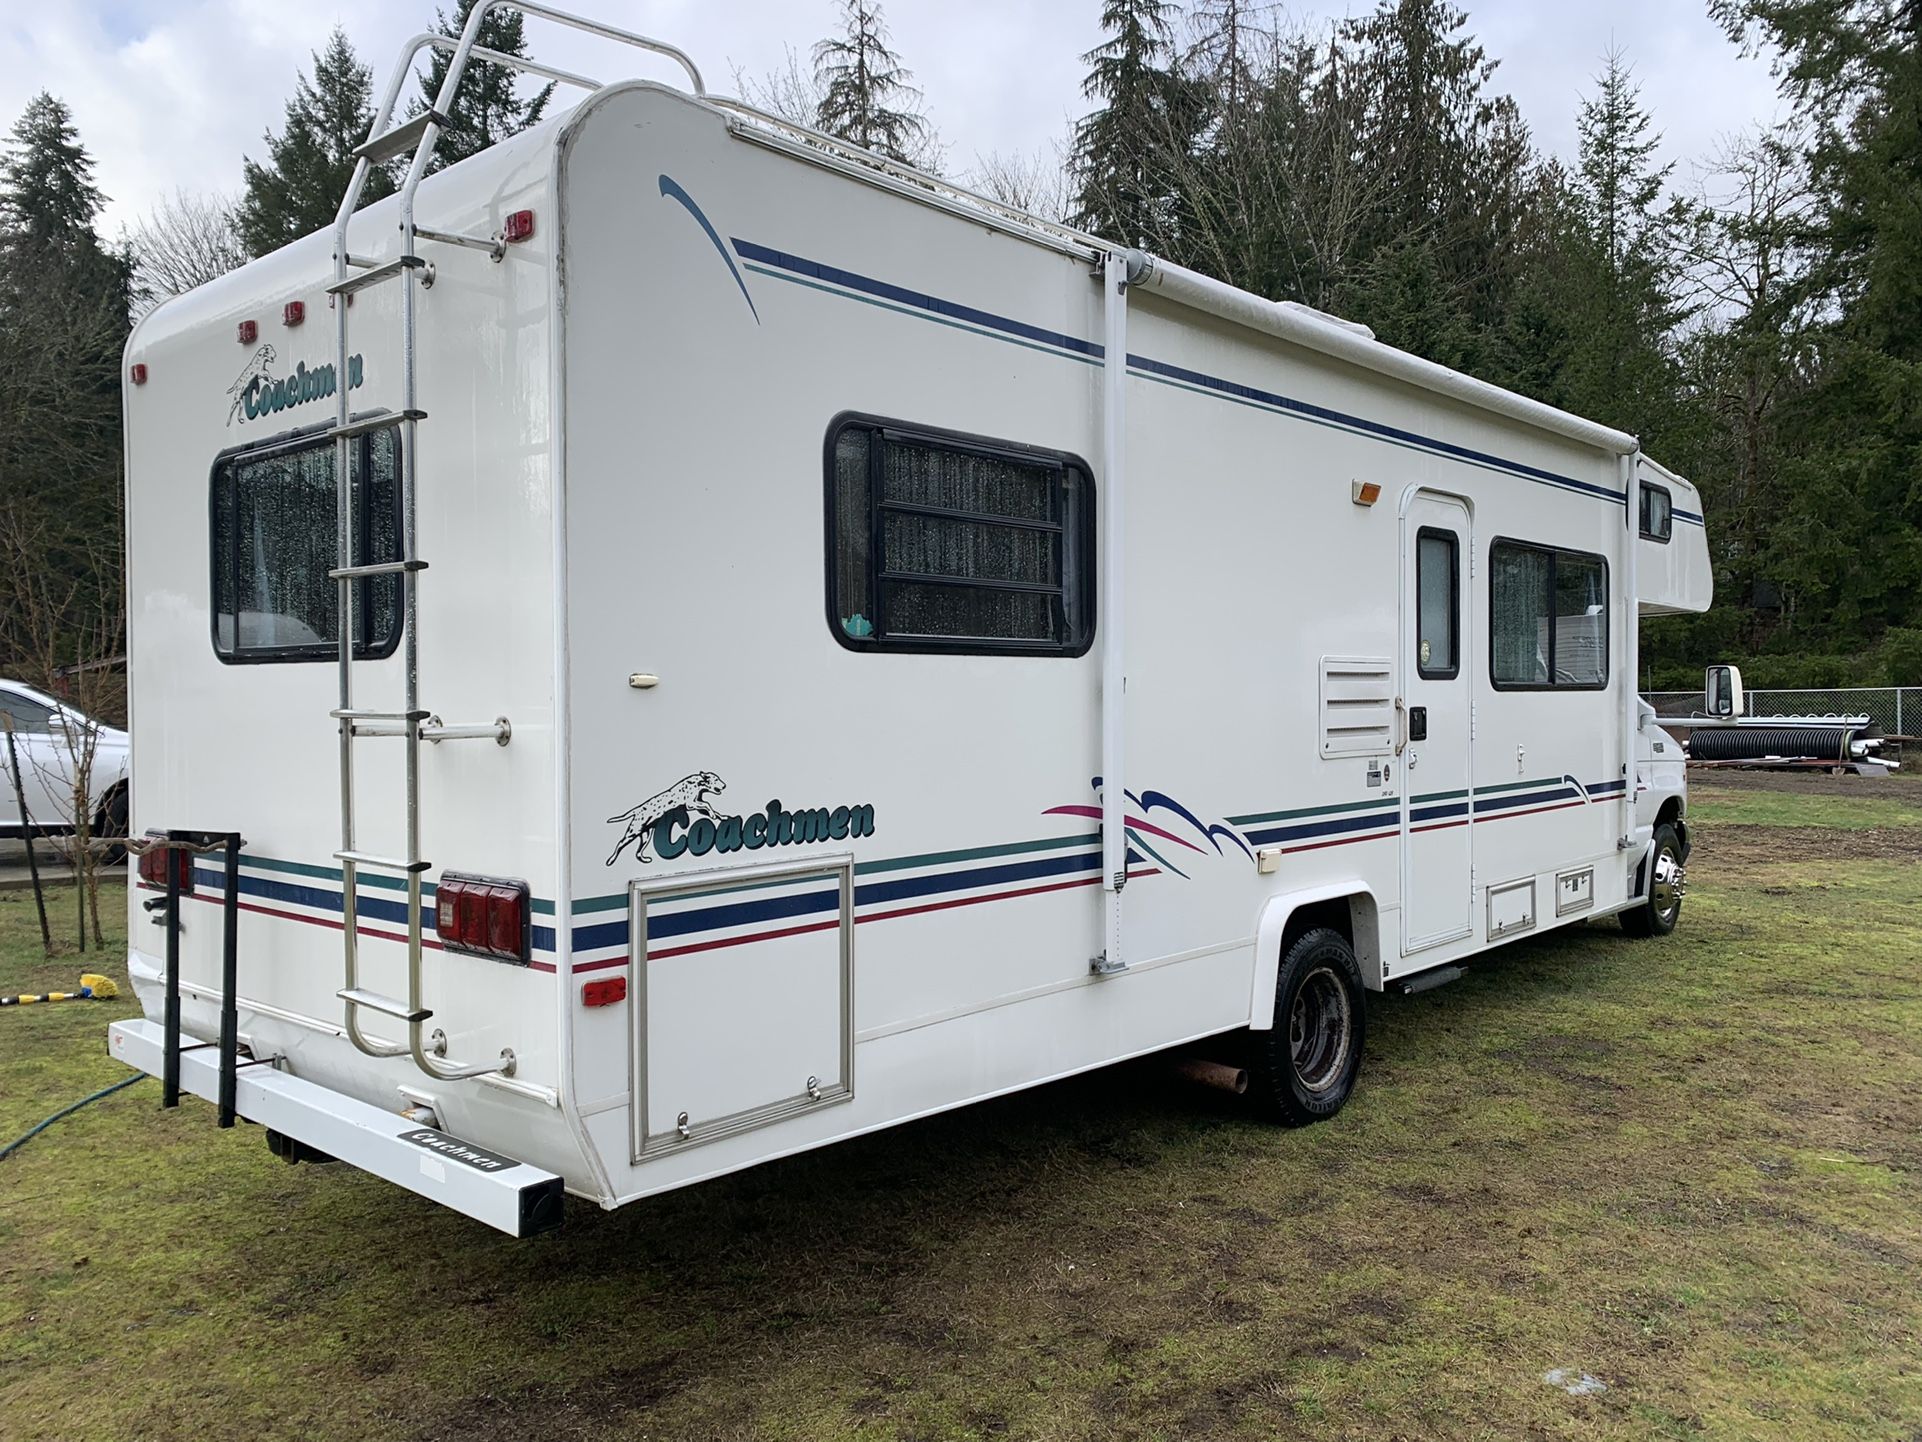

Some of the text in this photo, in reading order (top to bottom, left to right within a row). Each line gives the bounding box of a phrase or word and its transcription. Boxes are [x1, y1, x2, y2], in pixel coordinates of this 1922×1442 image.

[243, 353, 363, 420] Coachmn
[652, 799, 875, 860] Coachmen
[411, 1131, 502, 1169] Coachmen
